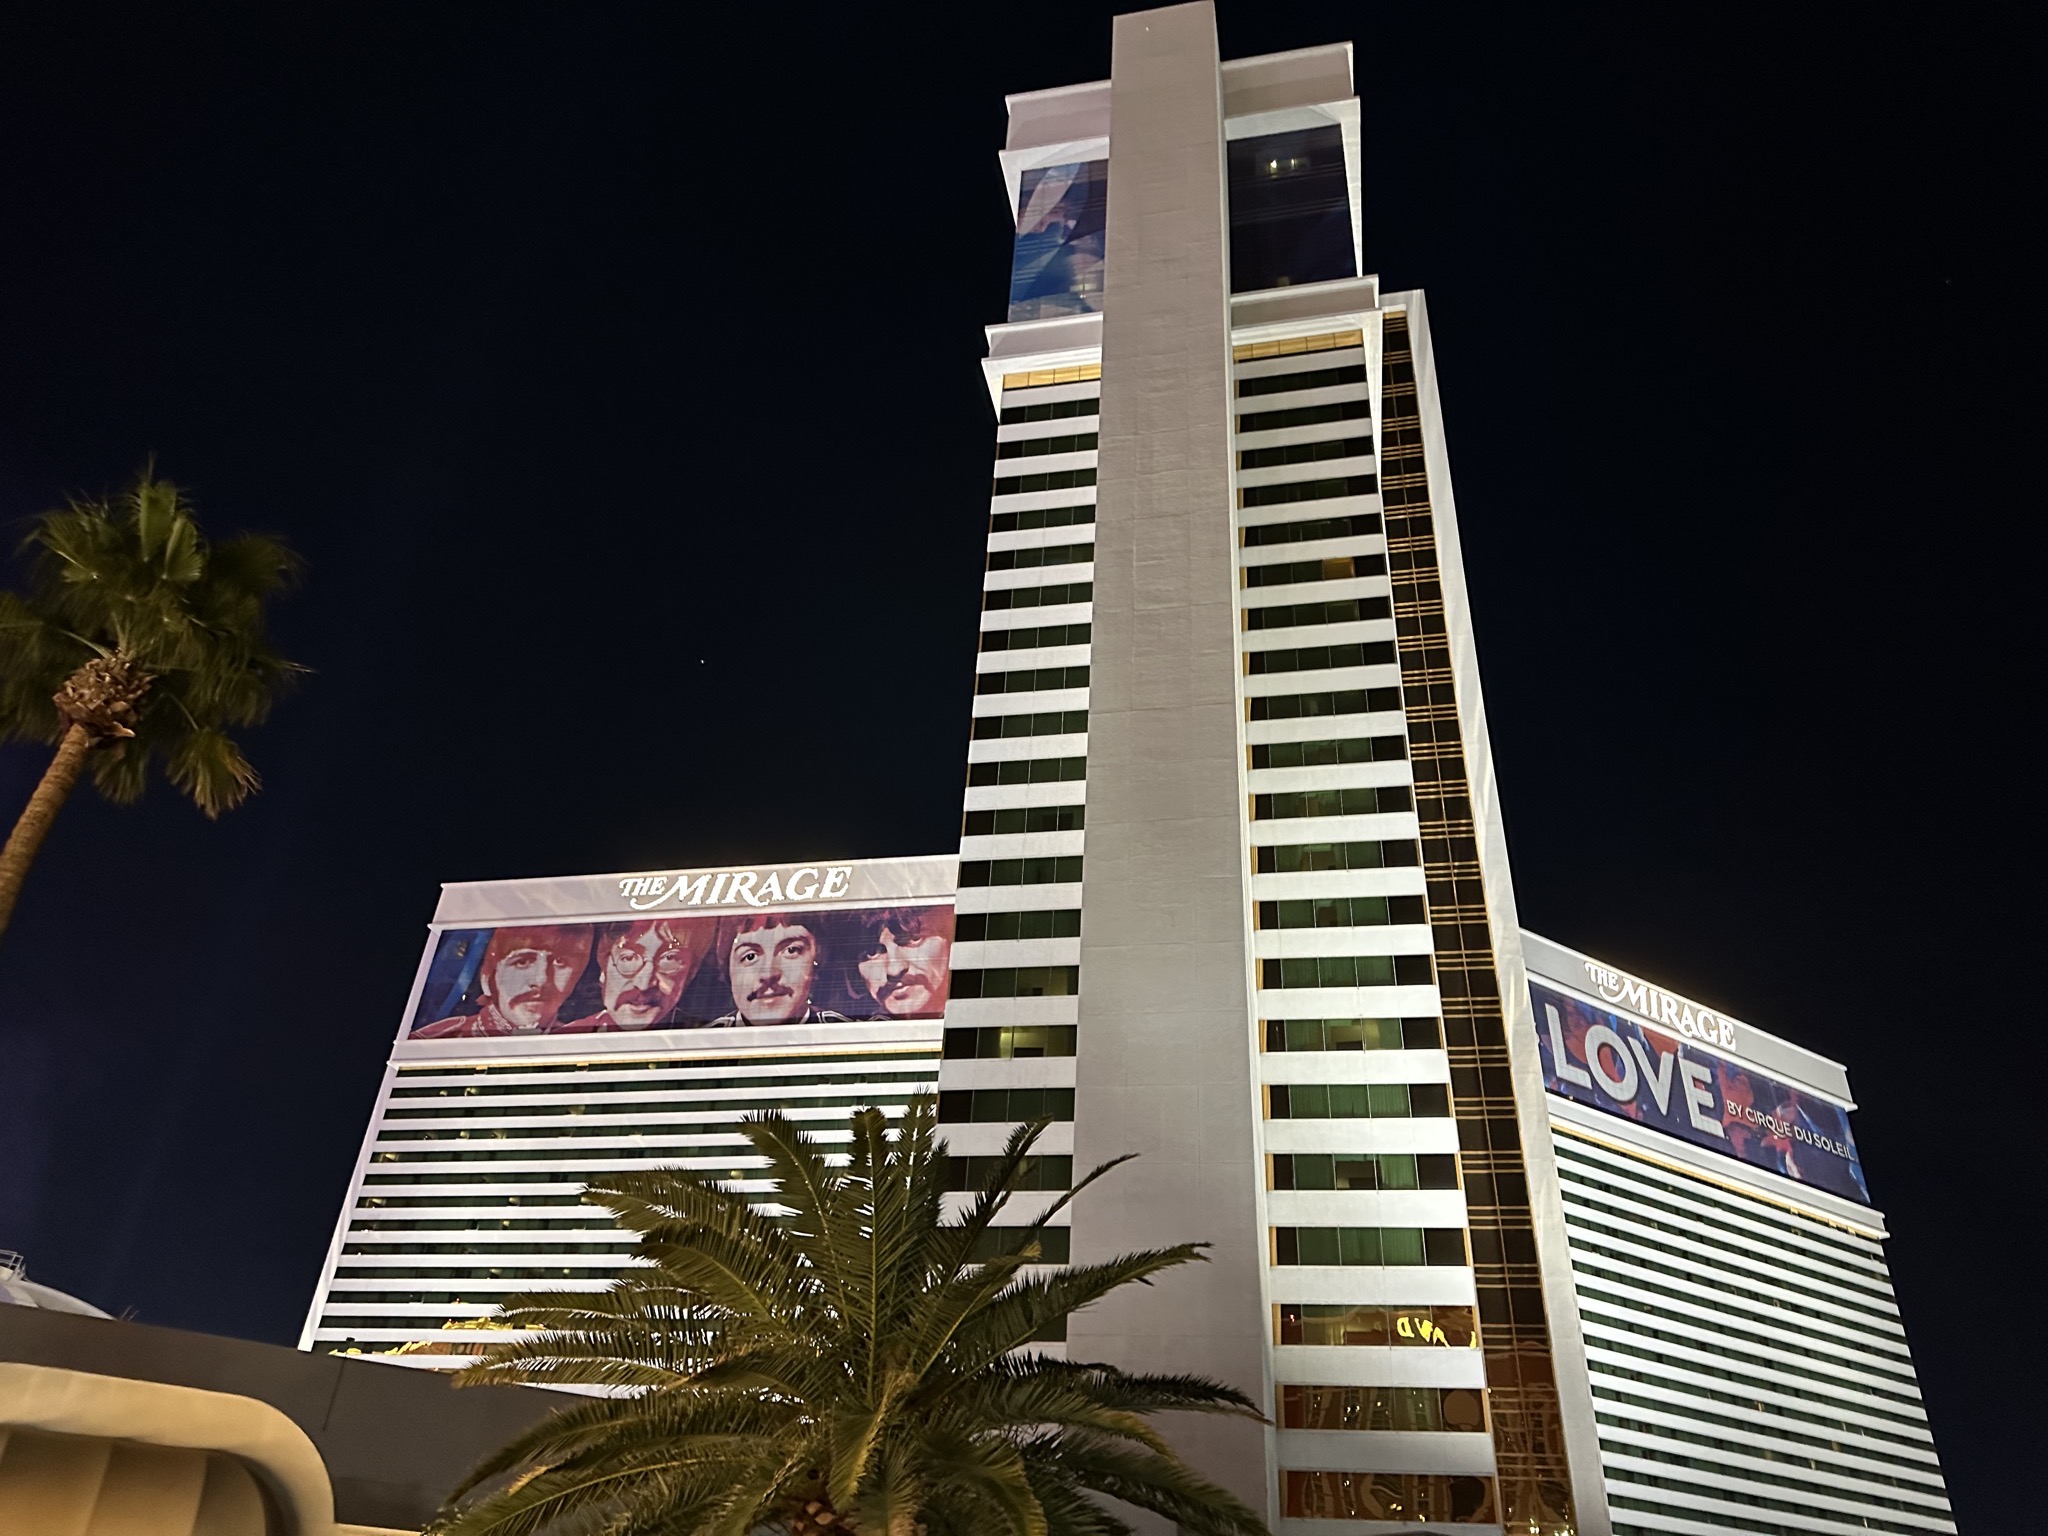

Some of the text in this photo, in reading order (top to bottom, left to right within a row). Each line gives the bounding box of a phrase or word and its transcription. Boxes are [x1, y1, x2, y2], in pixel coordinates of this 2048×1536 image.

[619, 866, 853, 910] THE MIRAGE
[1584, 962, 1737, 1052] THE MIRAGE
[1545, 1003, 1726, 1139] LOVE
[1727, 1099, 1857, 1162] BY CIRQUE DU SOLEIL
